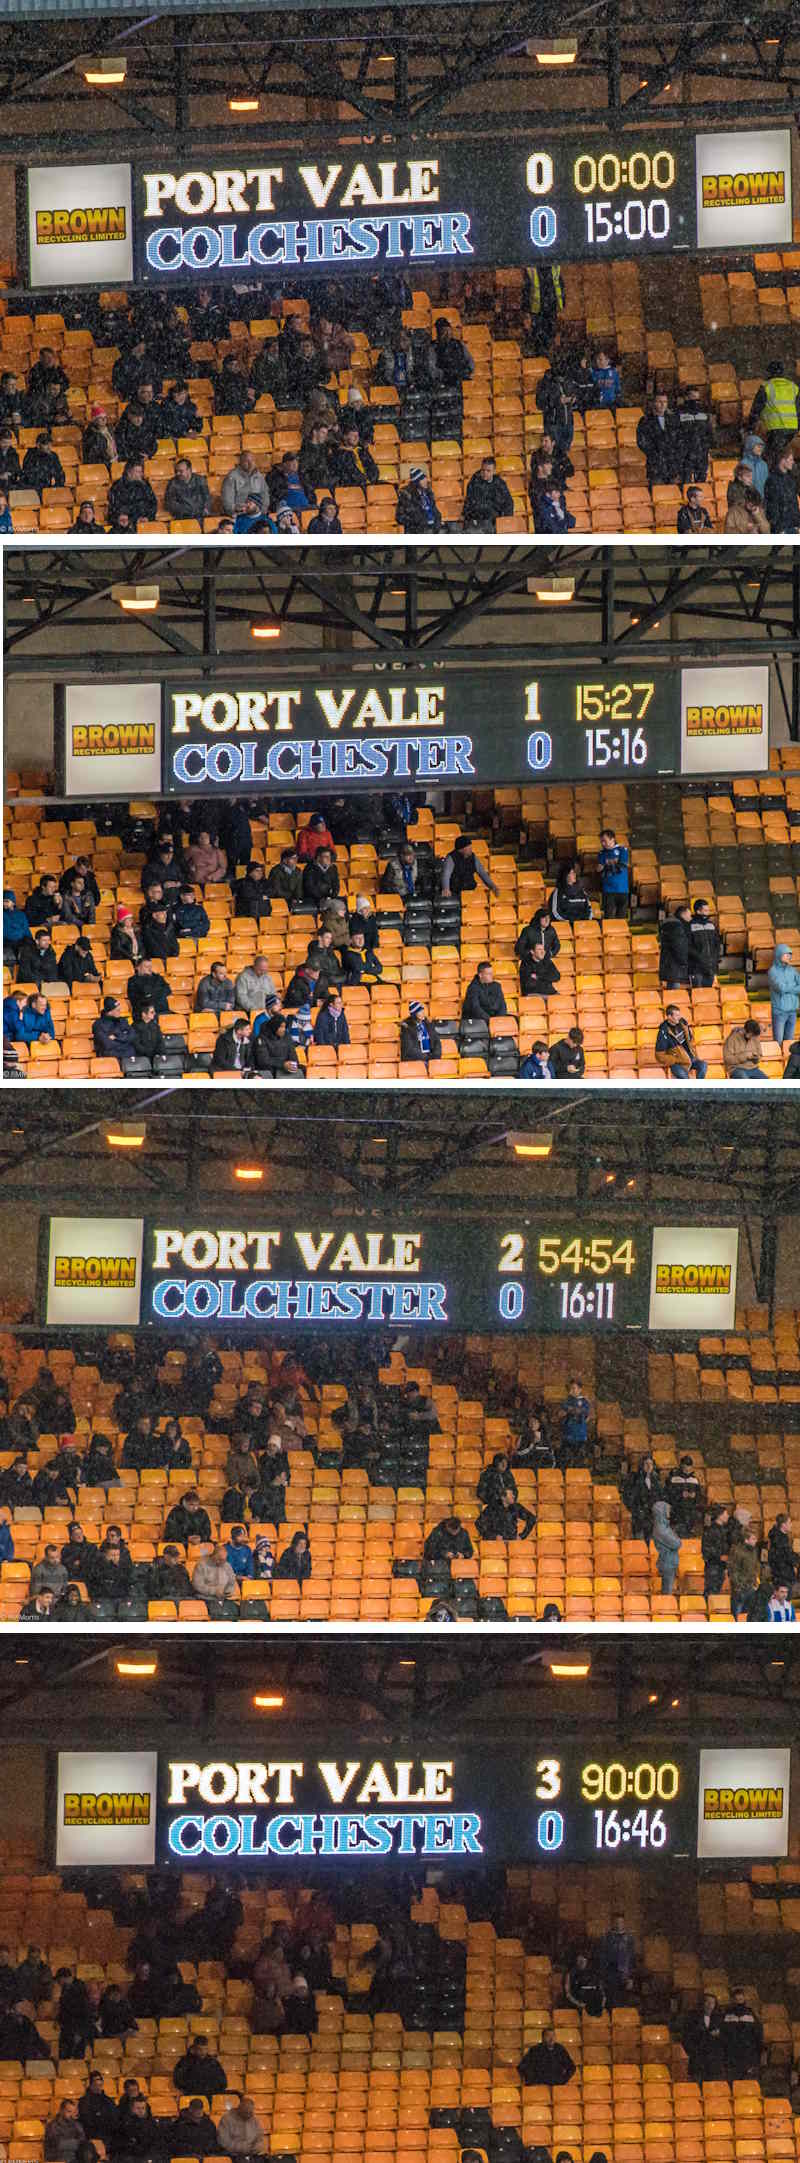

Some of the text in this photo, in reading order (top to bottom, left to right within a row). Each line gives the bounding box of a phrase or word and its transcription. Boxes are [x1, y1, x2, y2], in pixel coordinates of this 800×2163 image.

[143, 152, 554, 216] PORT VALE 0
[574, 151, 675, 193] 00:00
[702, 171, 785, 199] BROWN
[703, 196, 784, 207] RECYCLING LIMITED
[36, 207, 126, 235] BROWN
[584, 199, 670, 243] 15:00
[38, 232, 125, 243] RECYCLING LIMITED
[146, 206, 557, 270] COLCHESTER 0
[171, 681, 542, 733] PORT VALE 1
[576, 682, 655, 721] 15:27
[687, 704, 763, 729] BROWN
[72, 723, 155, 748] BROWN
[585, 728, 648, 766] 15:16
[688, 727, 762, 736] RECYCLING LIMITED
[73, 748, 120, 756] RECYCLING
[173, 731, 552, 783] COLCHESTER 0
[152, 1229, 524, 1272] PORT VALE 2
[538, 1238, 635, 1274] 54:54
[55, 1256, 136, 1280] BROWN
[55, 1279, 101, 1287] RECYCLING
[656, 1264, 731, 1287] BROWN
[152, 1279, 524, 1320] COLCHESTER 0
[560, 1282, 614, 1319] 16:11
[656, 1286, 698, 1294] RECYCLING
[167, 1759, 561, 1804] PORT VALE 3
[581, 1763, 679, 1800] 90:00
[64, 1792, 150, 1818] BROWN
[704, 1788, 783, 1812] BROWN
[704, 1810, 782, 1819] RECYCLING LIMITED
[65, 1817, 149, 1825] RECYCLING LIMITED
[168, 1810, 564, 1855] COLCHESTER 0
[594, 1809, 666, 1849] 16:46
